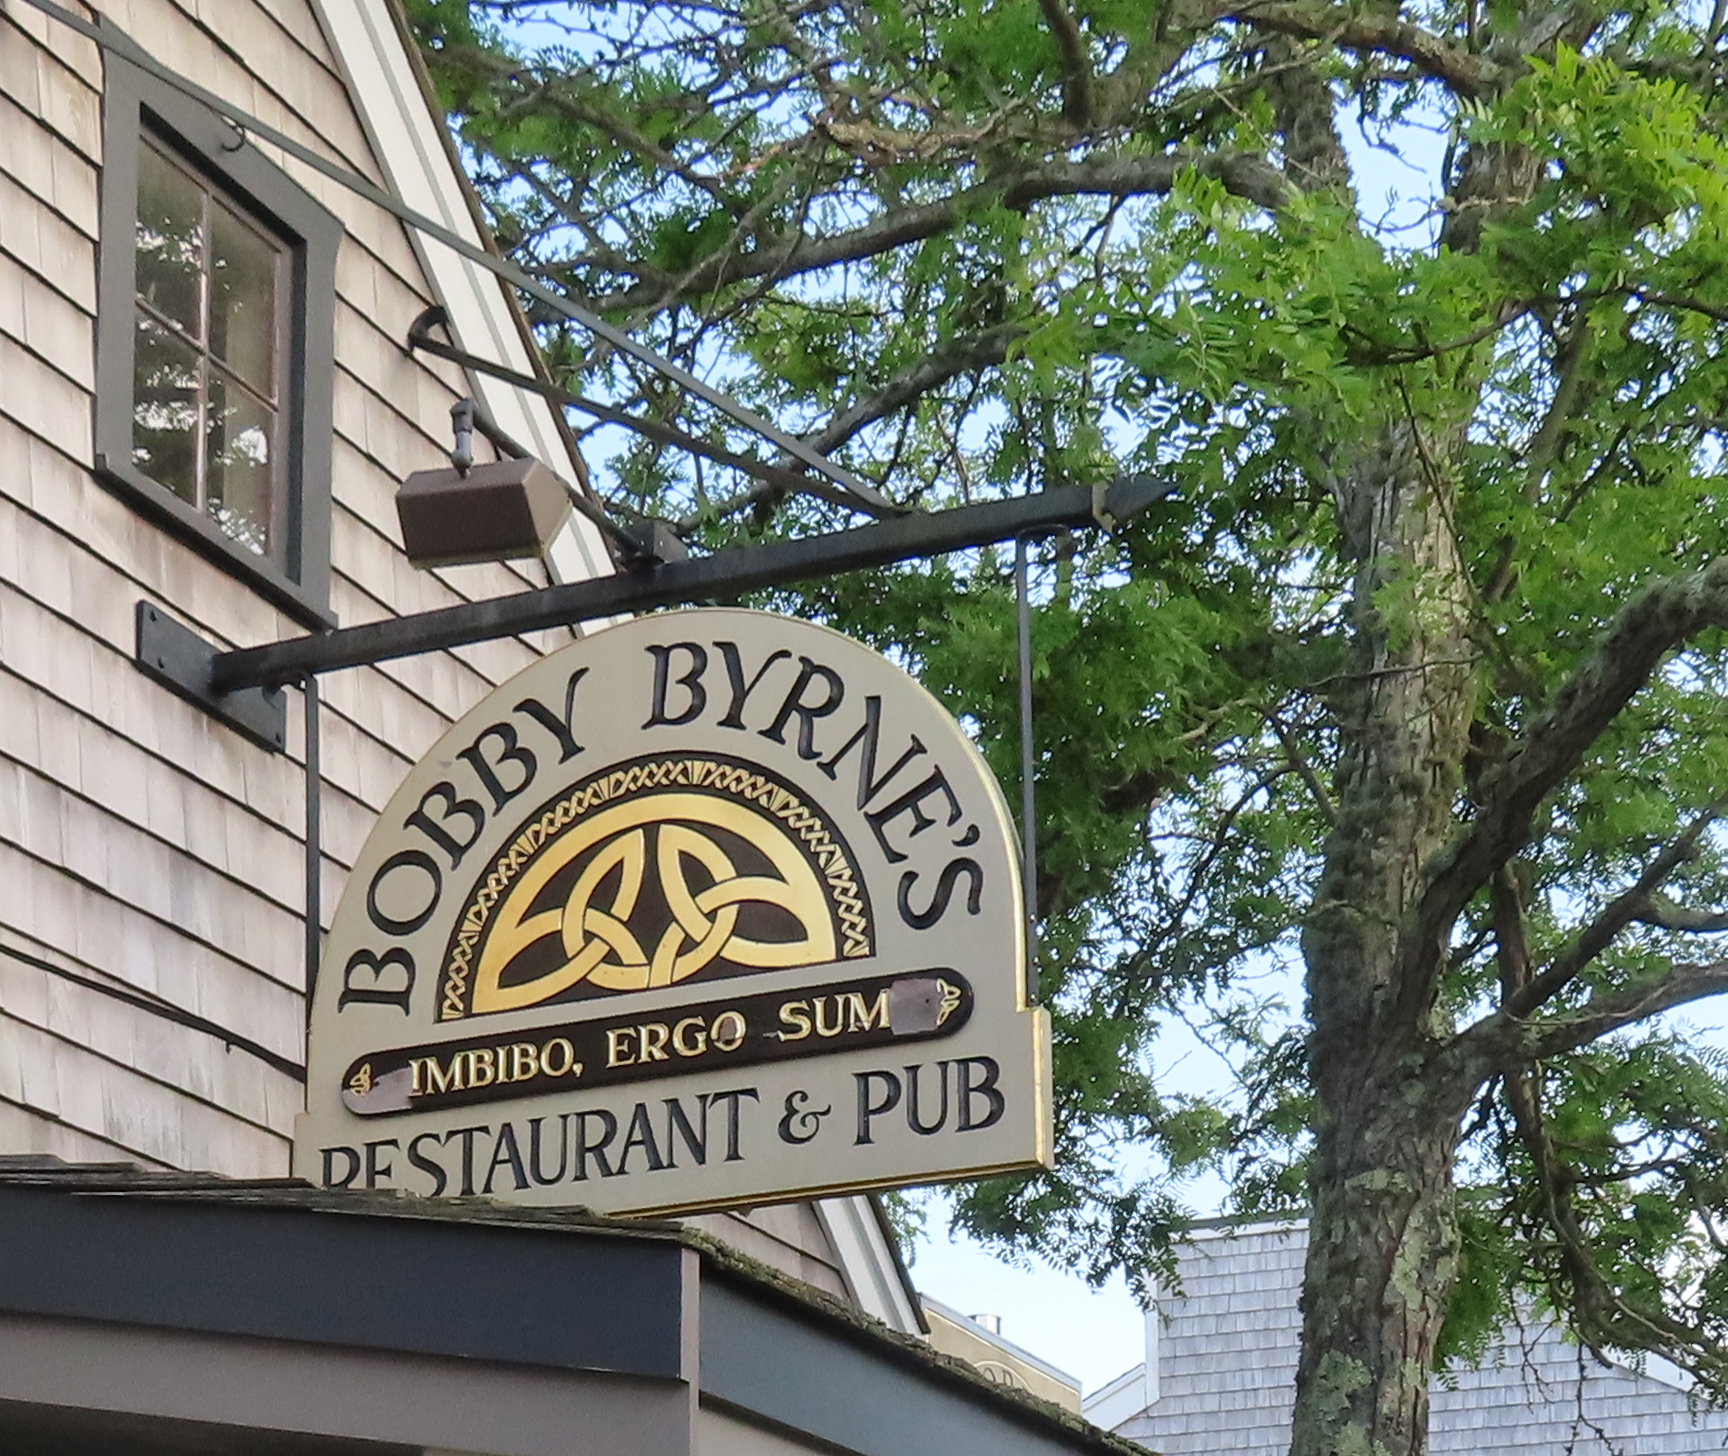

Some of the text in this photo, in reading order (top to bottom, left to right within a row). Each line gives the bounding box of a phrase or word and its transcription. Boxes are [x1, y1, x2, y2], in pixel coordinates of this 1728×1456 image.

[338, 640, 985, 1017] BOBBY BYRNE'S
[408, 987, 892, 1098] IMBIBO, ERGO SUM
[320, 1055, 1007, 1198] RESTAURANT & PUB
